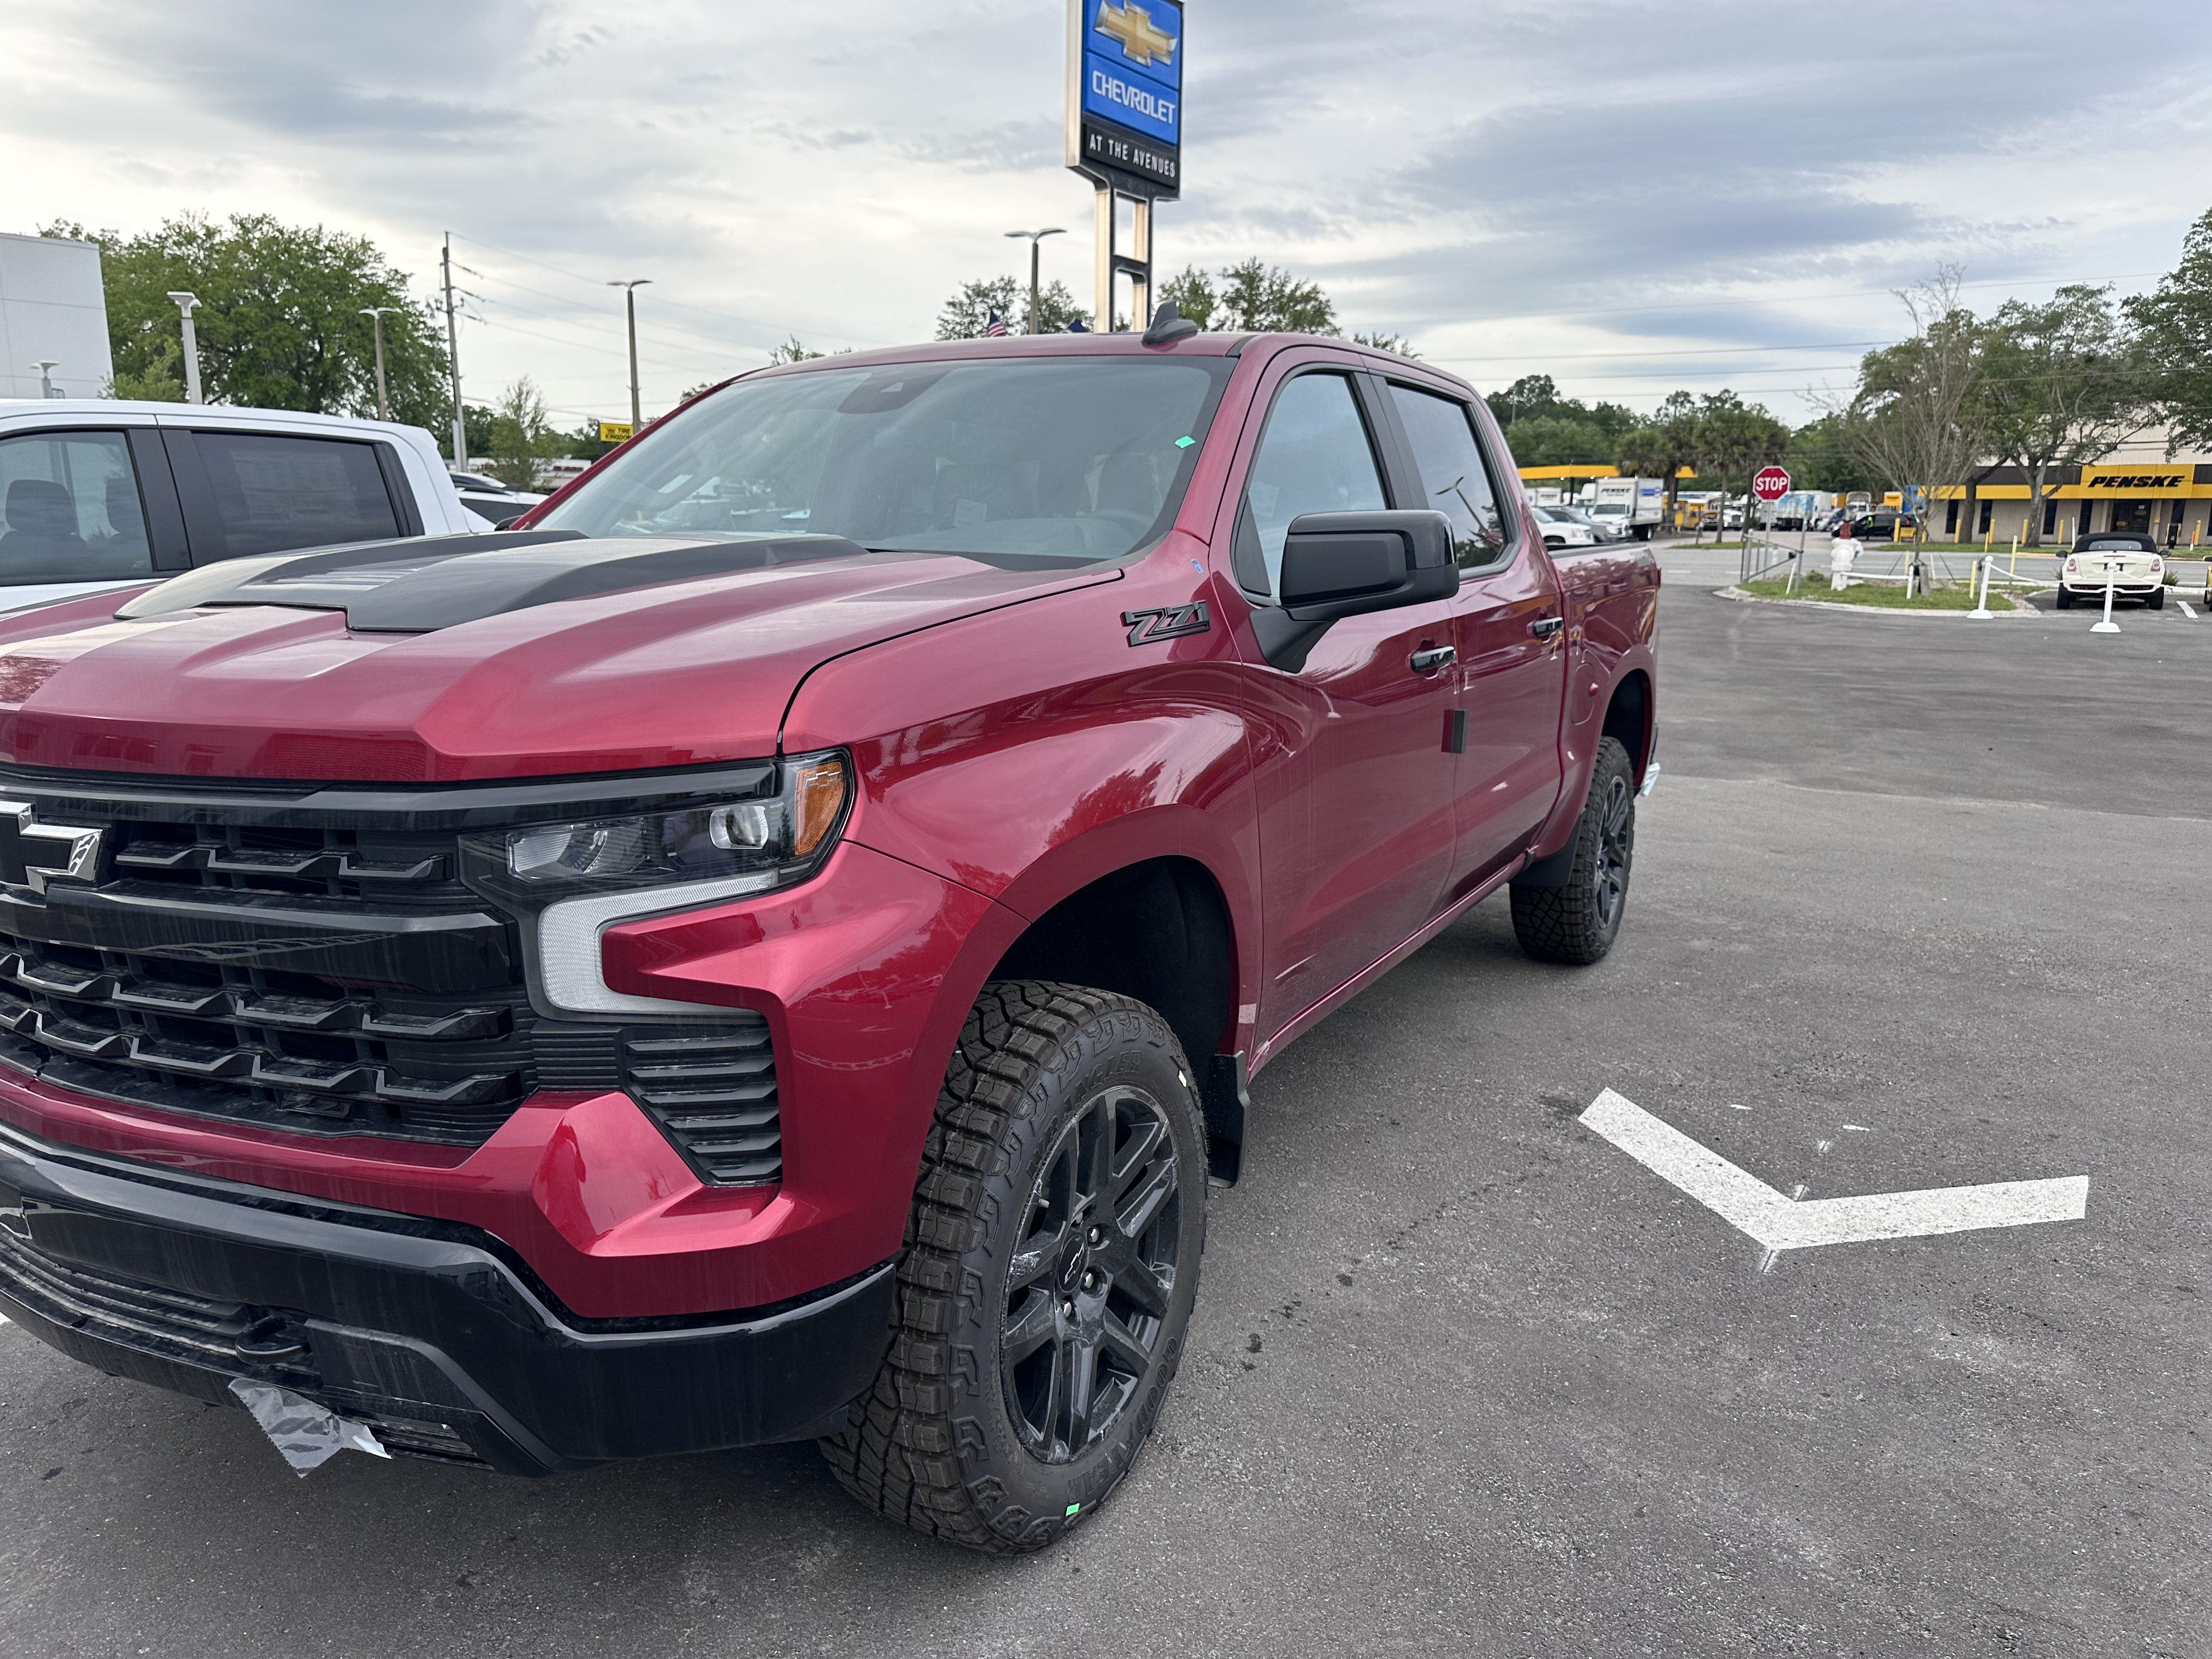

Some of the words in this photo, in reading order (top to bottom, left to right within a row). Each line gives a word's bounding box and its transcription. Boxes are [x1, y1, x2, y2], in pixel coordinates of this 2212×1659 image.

[1092, 70, 1176, 125] CHEVROLET
[1089, 133, 1103, 153] AT
[1108, 139, 1128, 161] THE
[1132, 149, 1176, 178] AVENUES
[1756, 477, 1788, 492] STOP
[2088, 475, 2185, 488] PENSKE
[1120, 599, 1211, 648] Z71
[1066, 1336, 1177, 1504] GOODYEAR
